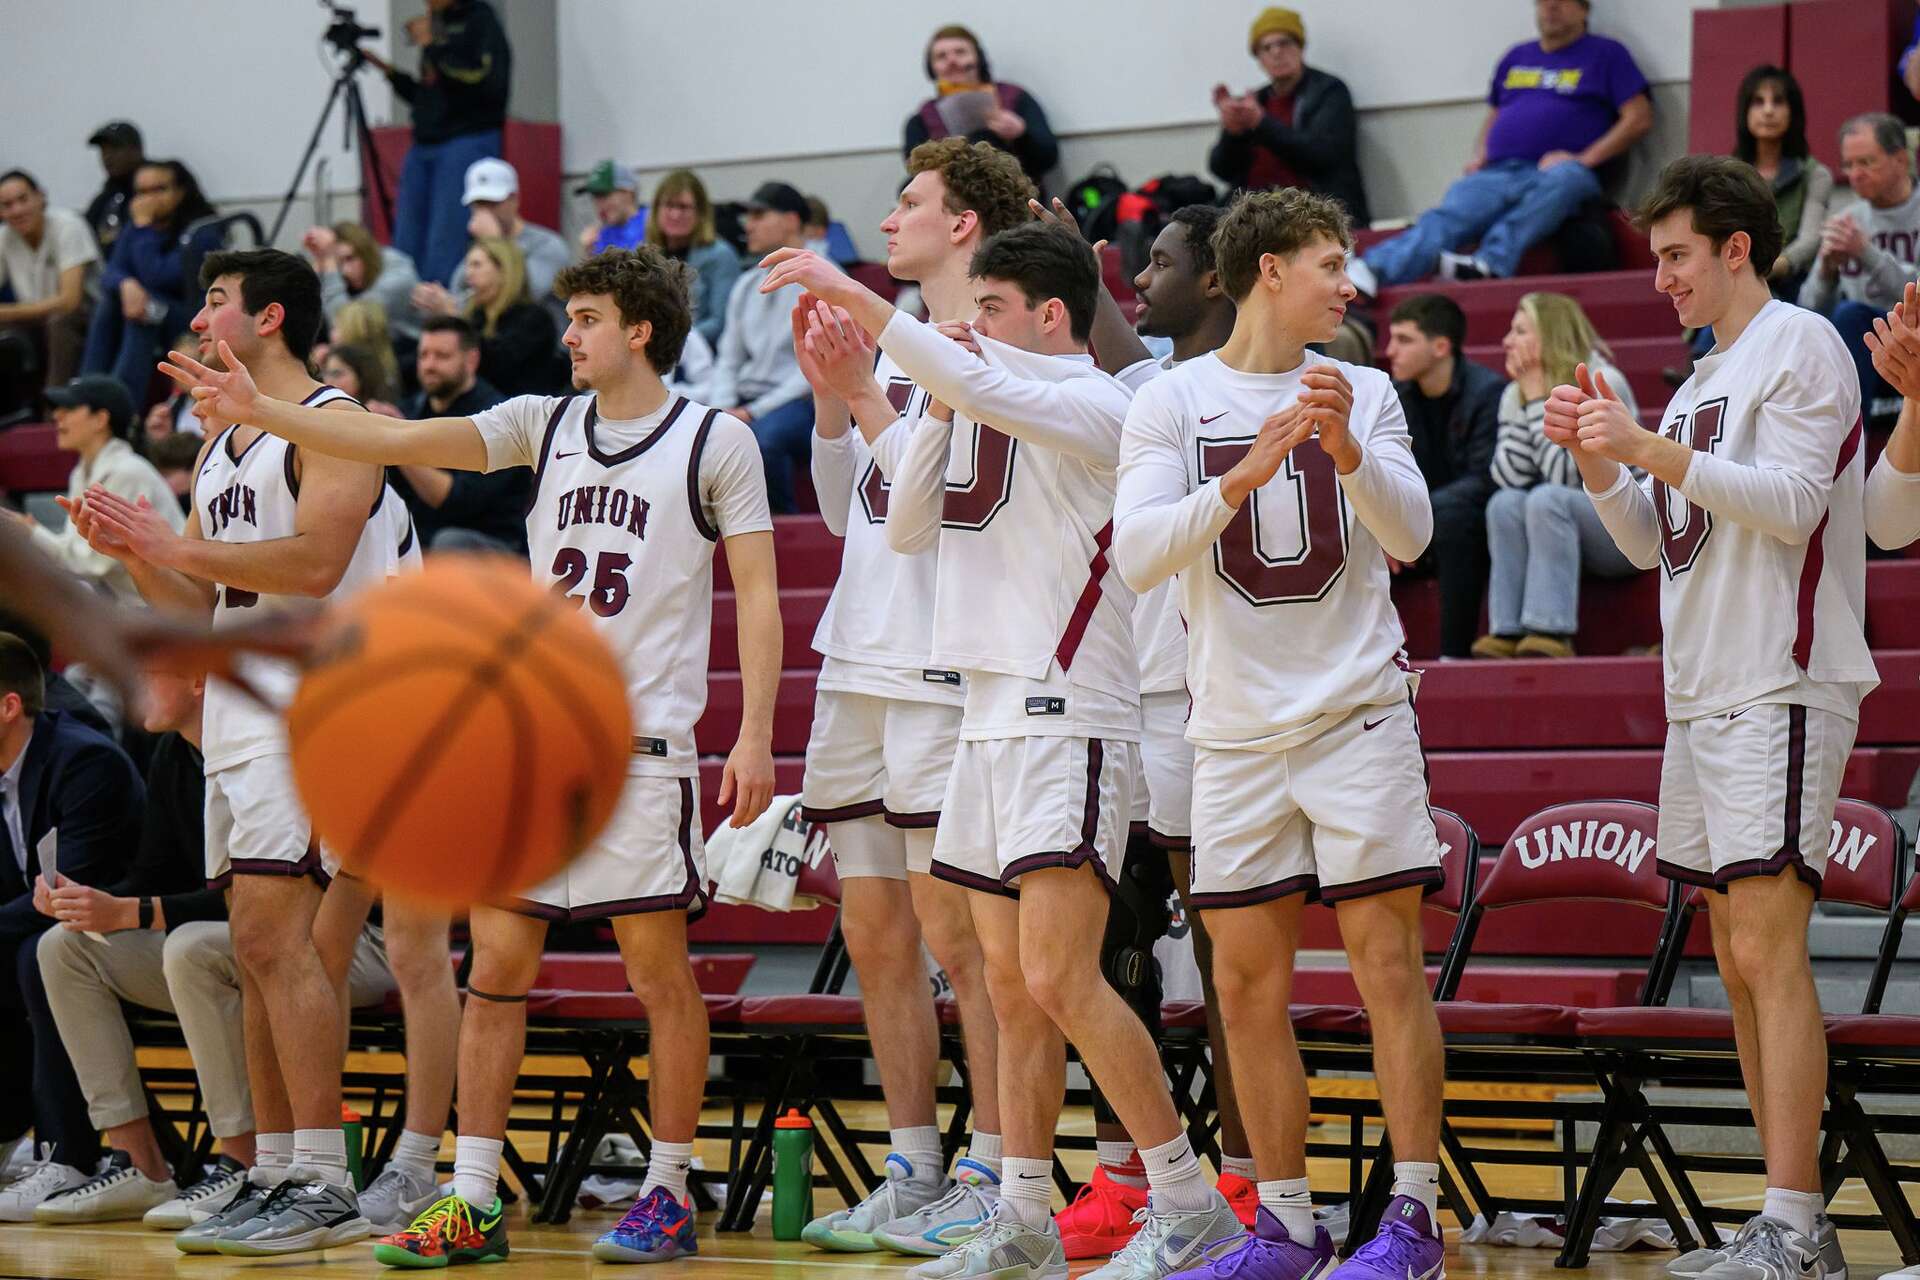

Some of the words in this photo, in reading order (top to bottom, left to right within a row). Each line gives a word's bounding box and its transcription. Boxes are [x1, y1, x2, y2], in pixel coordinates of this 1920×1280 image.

[557, 485, 650, 541] UNION
[551, 547, 633, 617] 25
[1051, 701, 1059, 709] M
[1514, 820, 1656, 874] UNION
